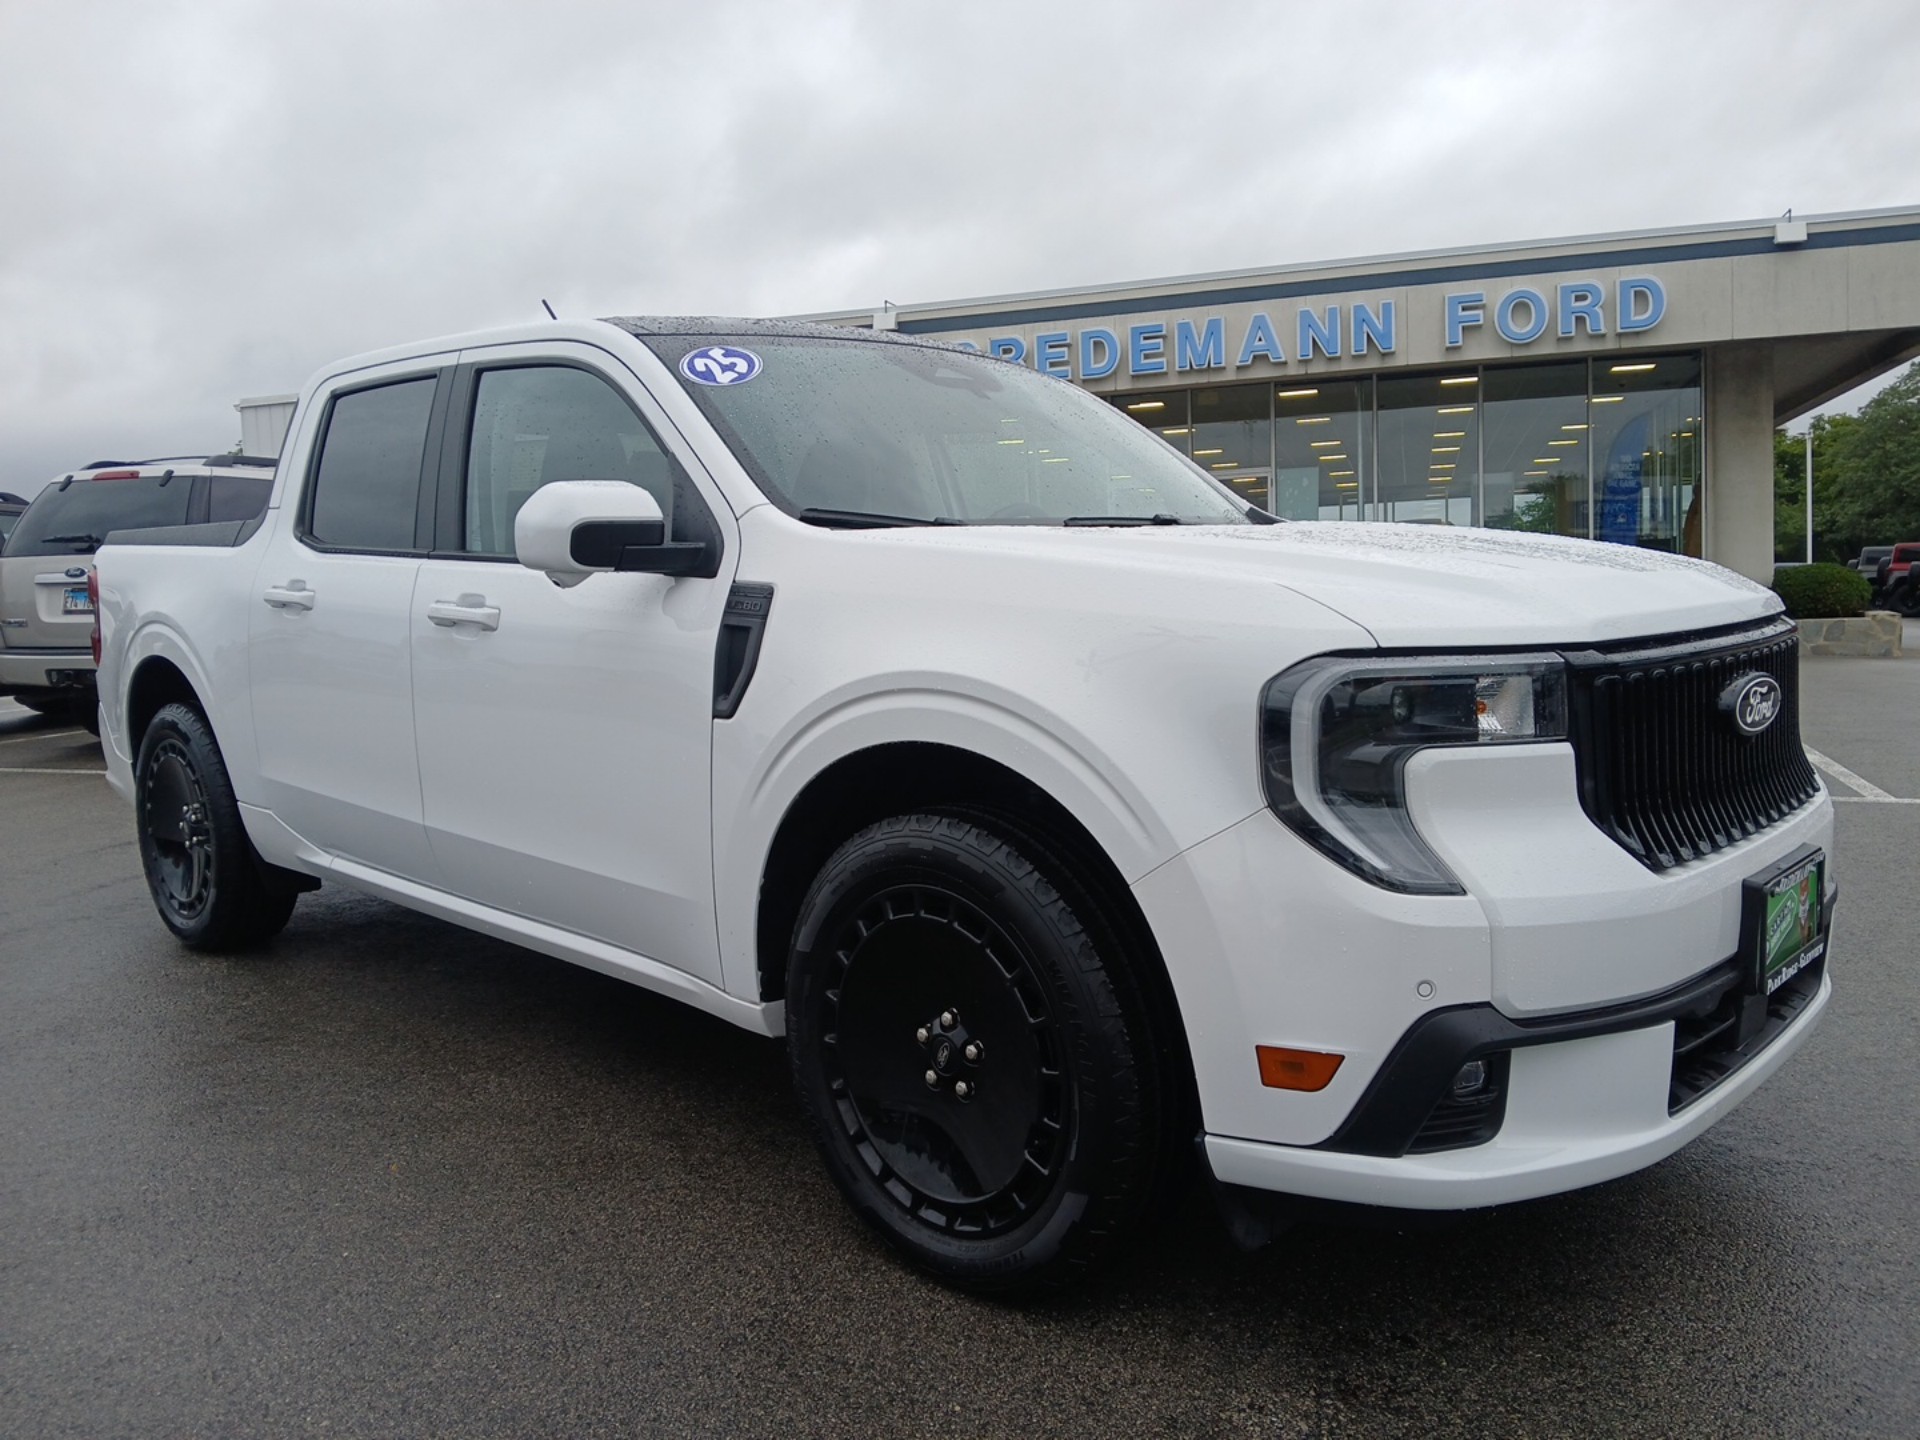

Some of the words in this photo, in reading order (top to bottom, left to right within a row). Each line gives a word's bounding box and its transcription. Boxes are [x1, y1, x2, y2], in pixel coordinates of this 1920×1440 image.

[957, 300, 1396, 380] REDEMANN
[1444, 276, 1666, 347] FORD
[693, 347, 749, 383] 25
[1745, 684, 1775, 724] Ford
